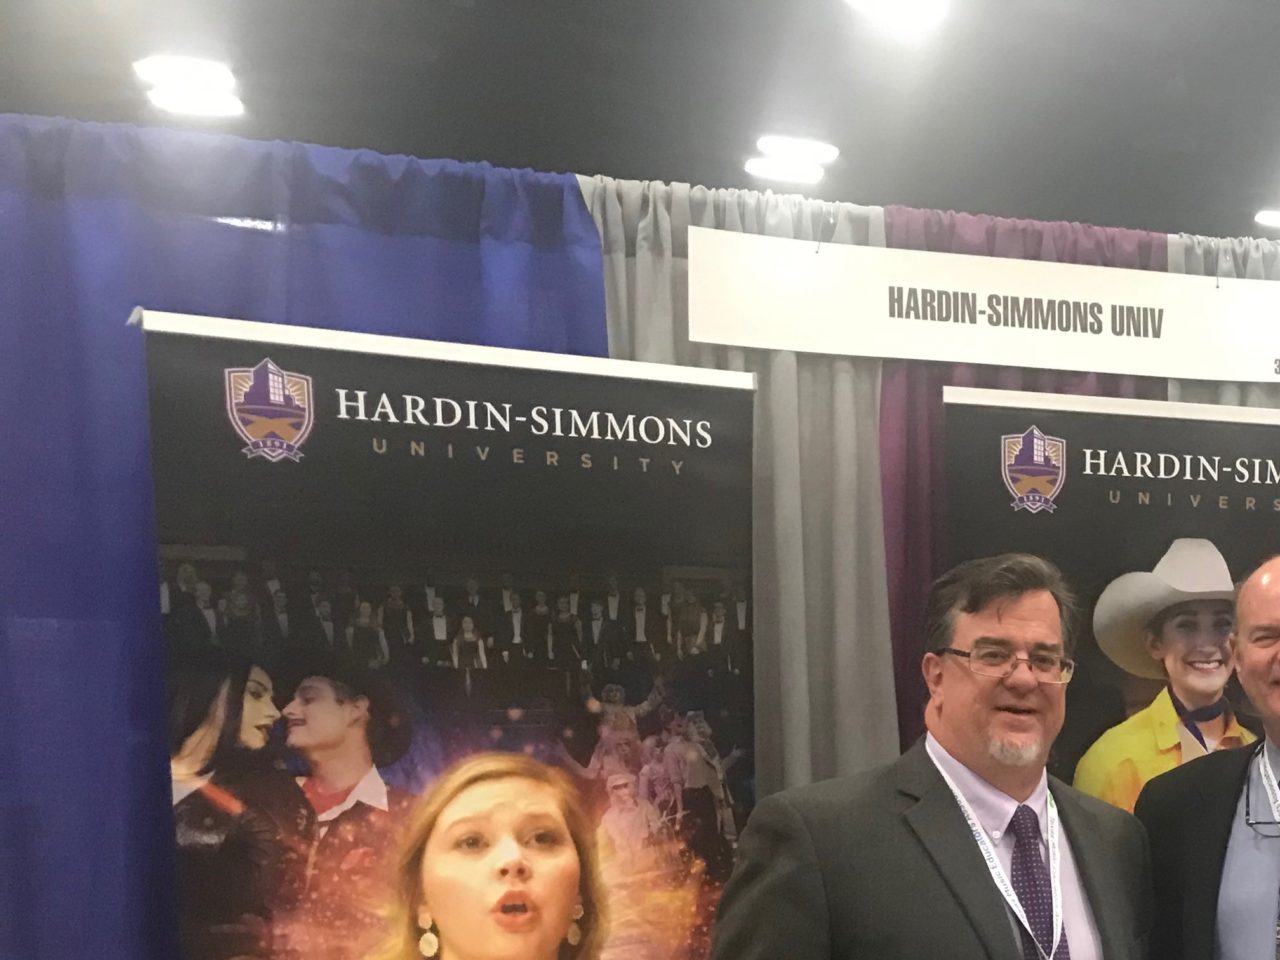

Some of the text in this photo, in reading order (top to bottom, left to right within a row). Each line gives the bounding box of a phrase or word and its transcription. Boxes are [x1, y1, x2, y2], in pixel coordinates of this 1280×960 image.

[887, 286, 1164, 339] HARDIN-SIMMONS UNIV
[335, 387, 713, 449] HARDIN-SIMMONS
[372, 437, 686, 475] UNIVERSITY
